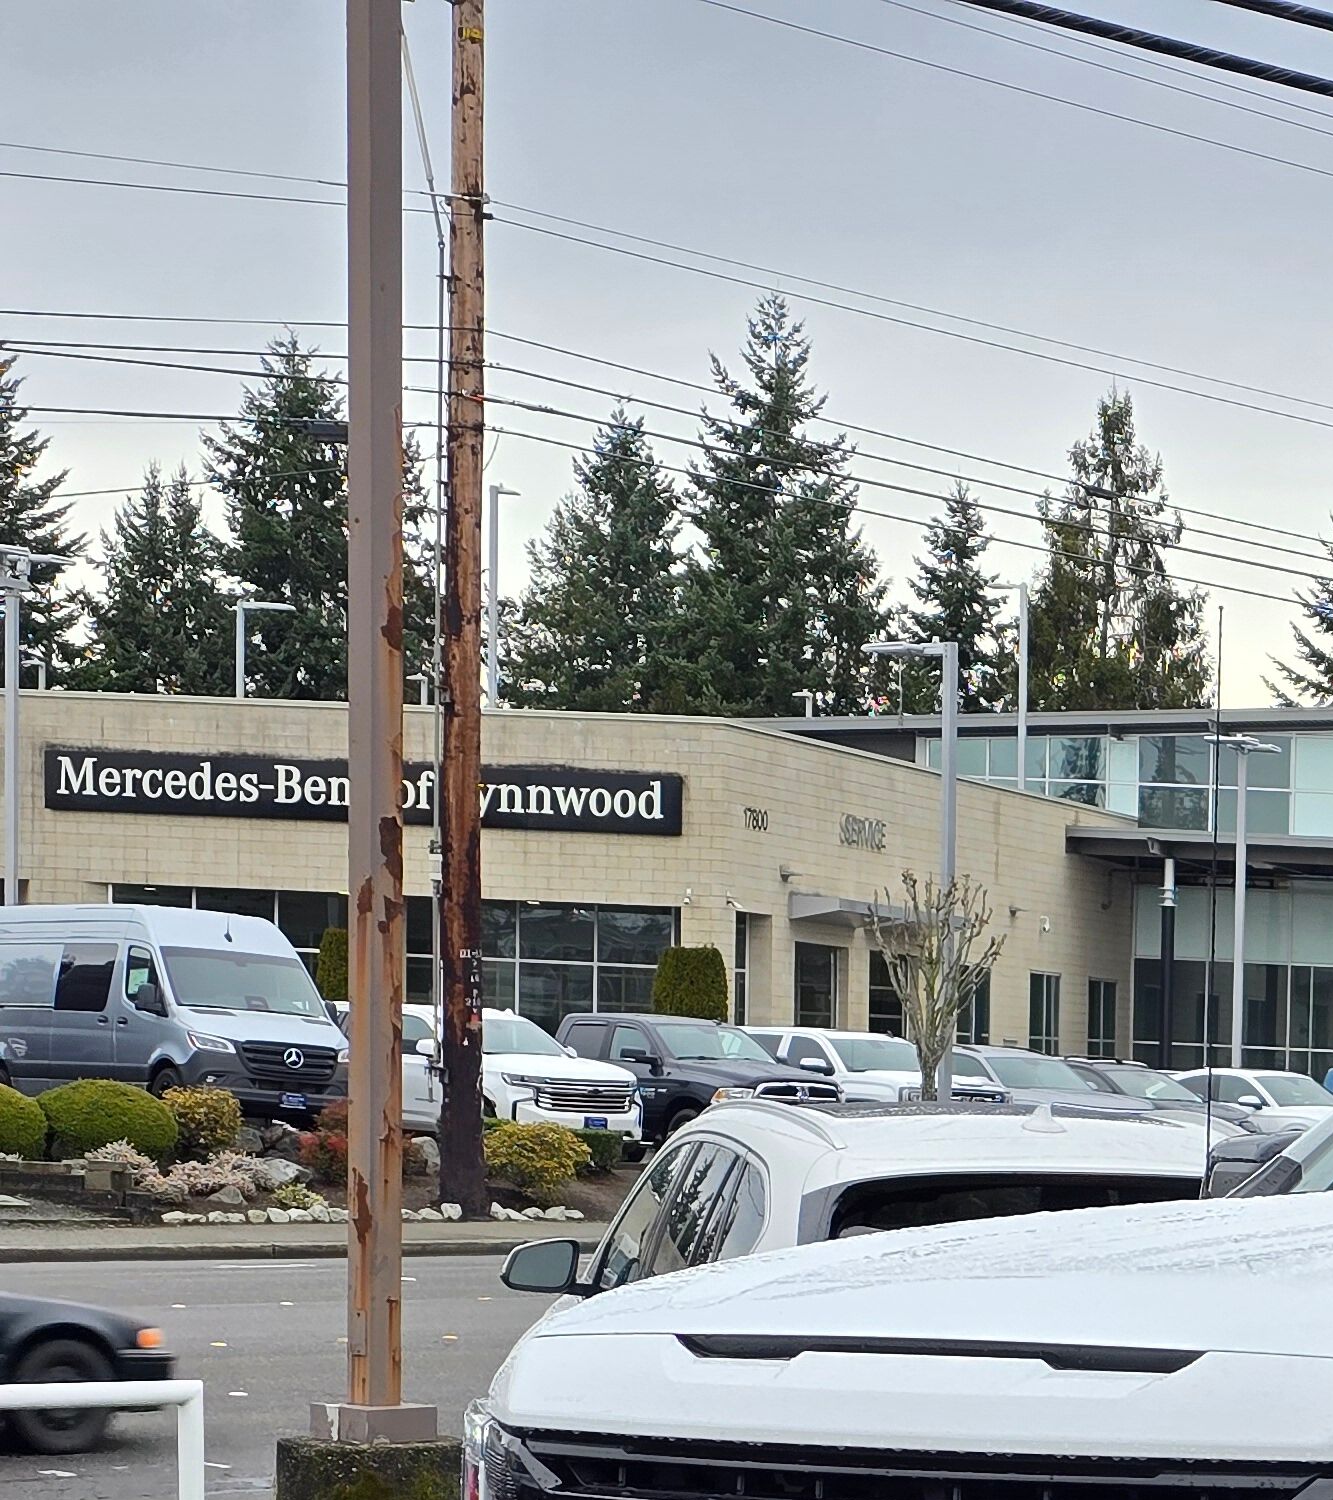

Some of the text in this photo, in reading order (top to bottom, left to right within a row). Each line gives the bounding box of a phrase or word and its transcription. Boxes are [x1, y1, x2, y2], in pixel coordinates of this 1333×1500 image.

[56, 756, 350, 806] Mercedes-Ben
[478, 780, 664, 820] ynnwood
[743, 807, 769, 831] 17800
[839, 813, 887, 851] SERVICE
